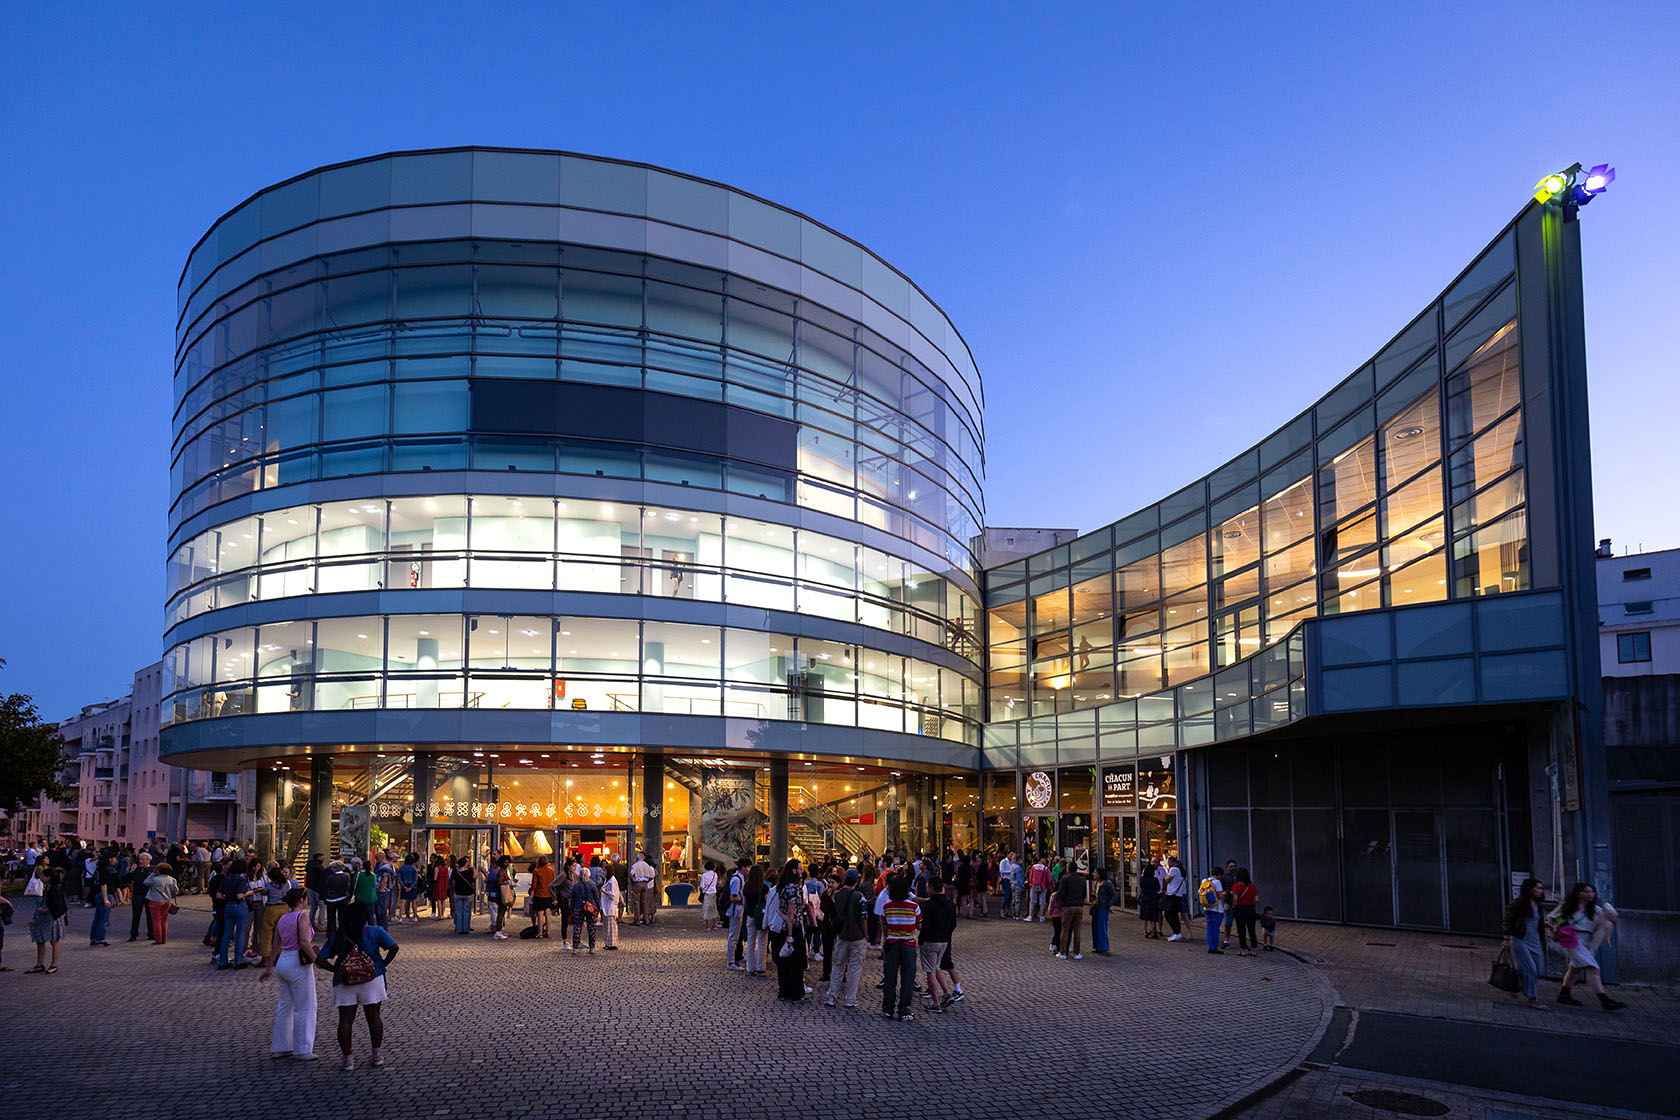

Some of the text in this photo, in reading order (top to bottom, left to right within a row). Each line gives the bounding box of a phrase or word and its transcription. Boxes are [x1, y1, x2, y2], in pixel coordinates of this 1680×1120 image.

[1105, 773, 1132, 783] CHACUN
[1035, 773, 1051, 796] CHACUN
[1113, 783, 1131, 791] PART
